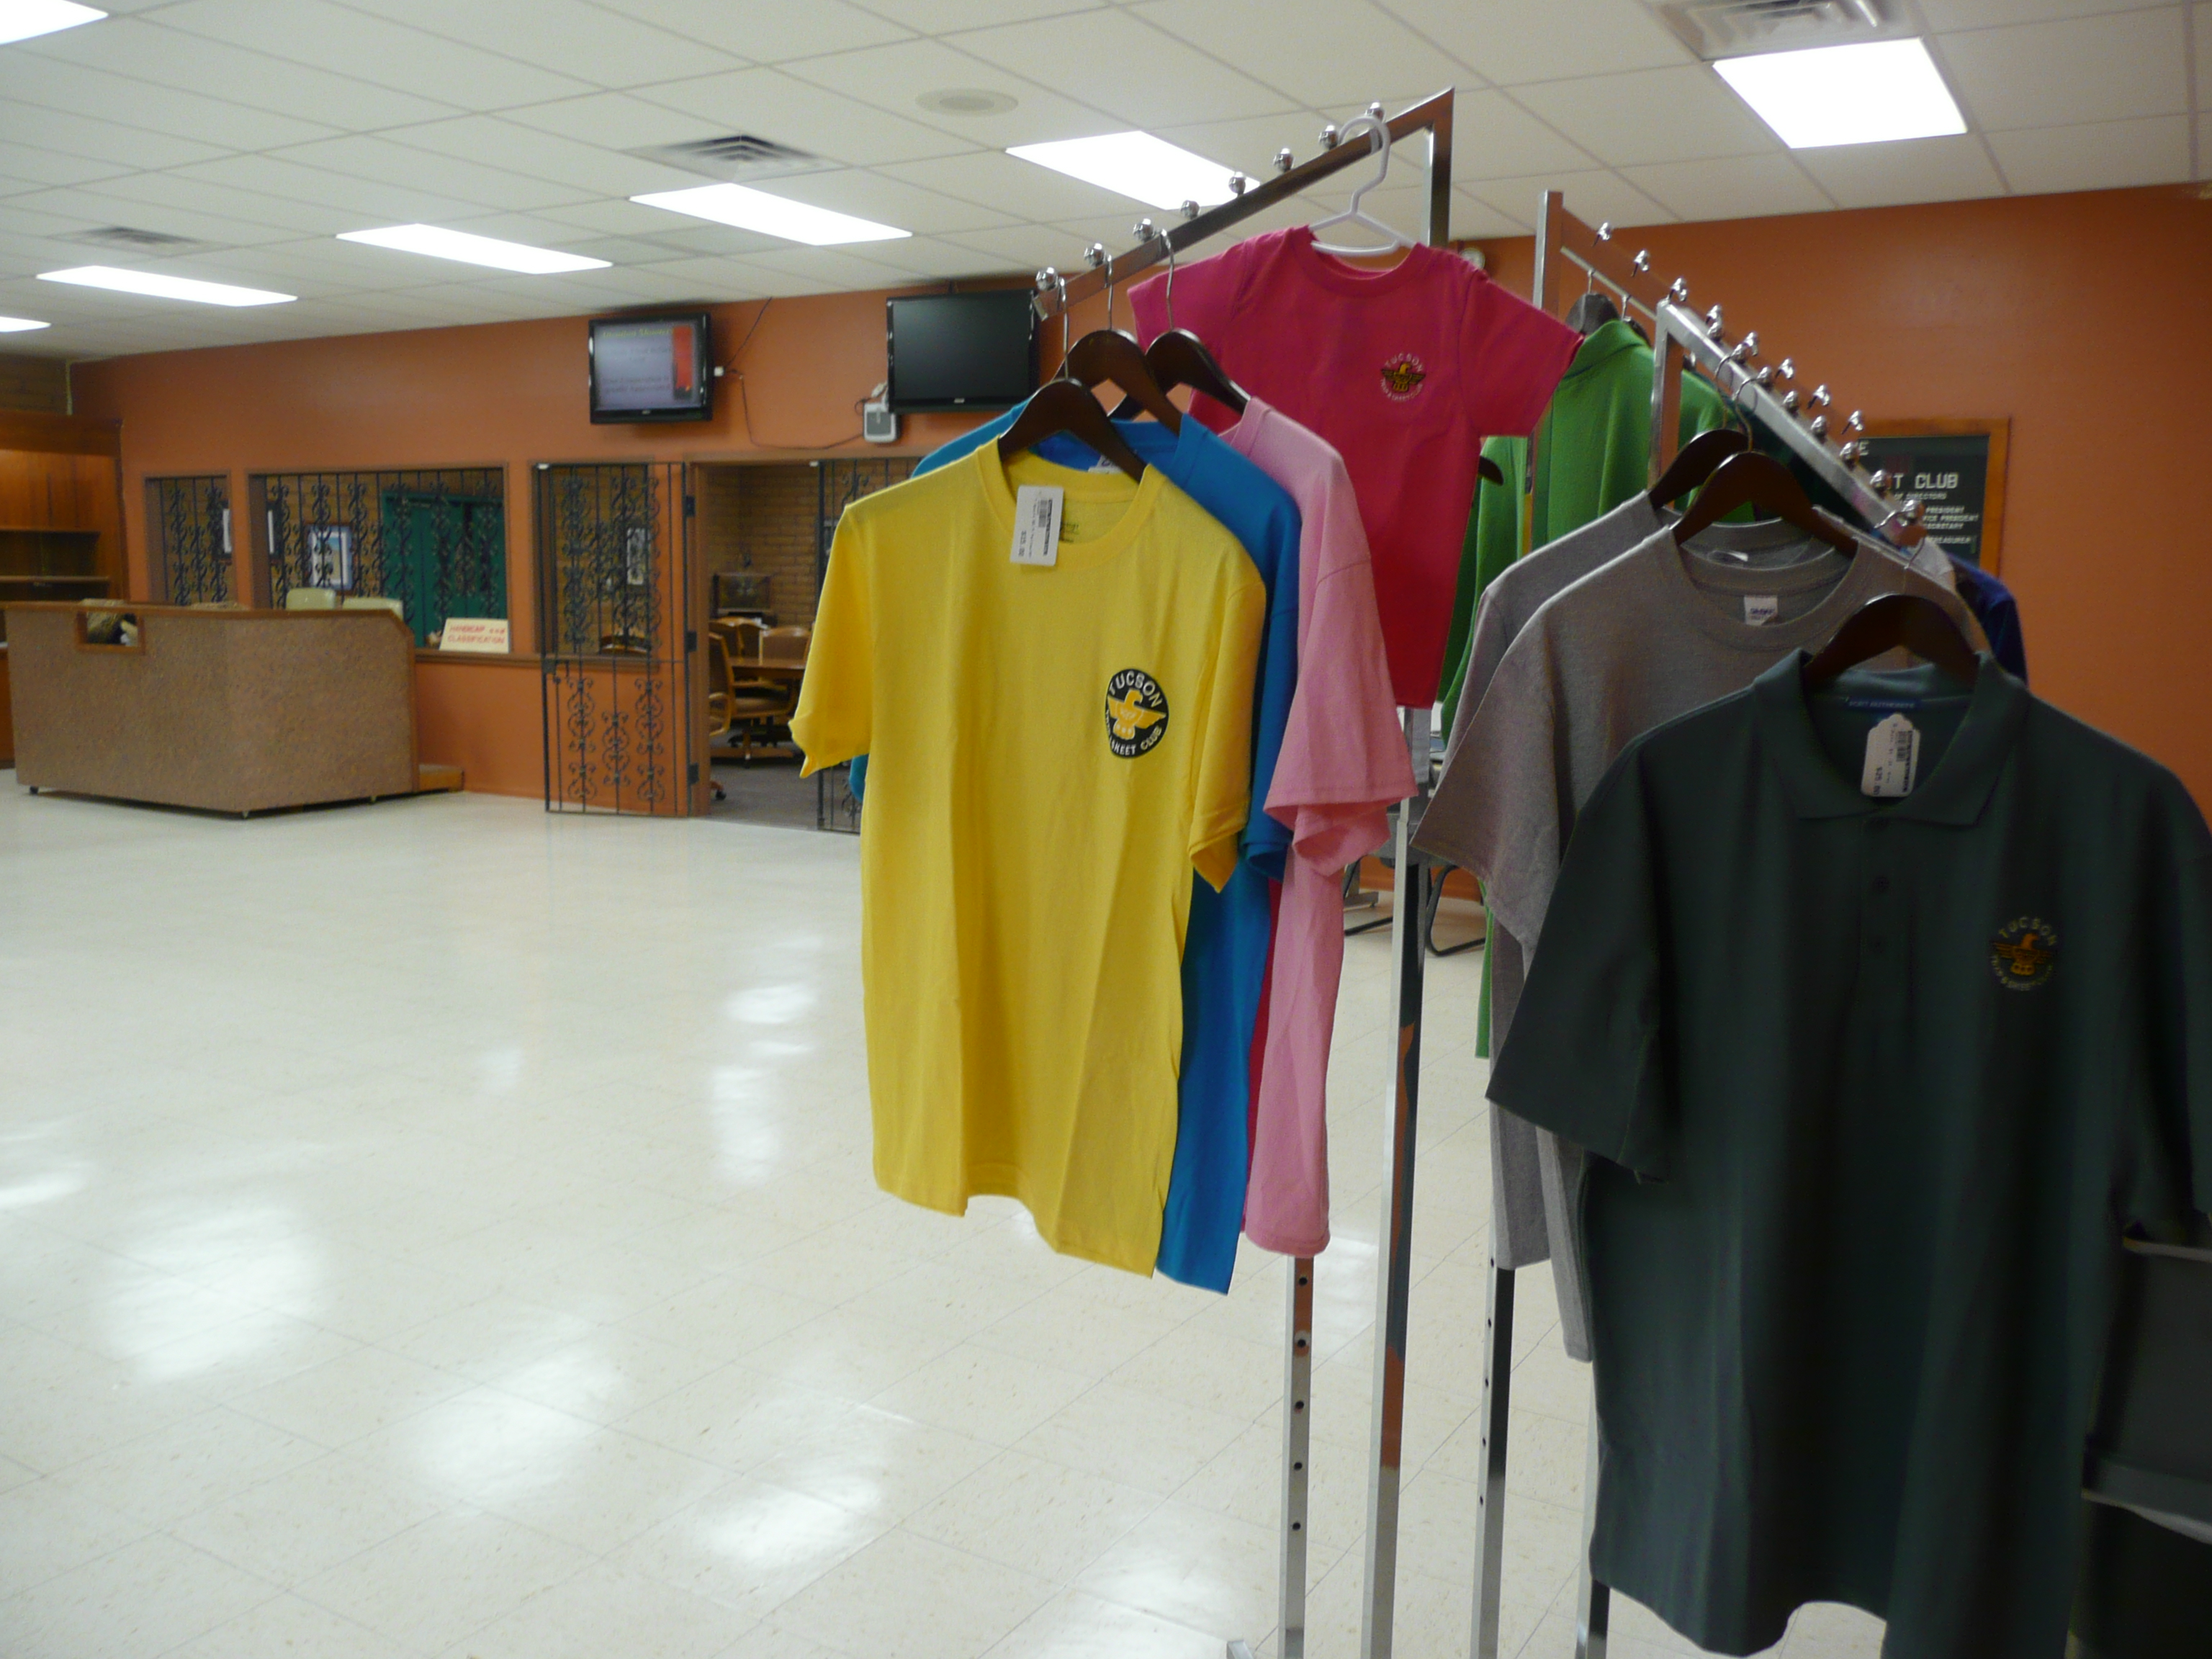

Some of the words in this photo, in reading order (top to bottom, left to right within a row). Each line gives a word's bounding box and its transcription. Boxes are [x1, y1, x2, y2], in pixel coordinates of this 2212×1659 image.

[1385, 353, 1424, 372] TUCSON
[1914, 472, 1959, 489] CLUB
[1925, 505, 1965, 514] PRESIDENT
[1940, 513, 1979, 522] PRESIDENT
[1109, 670, 1163, 708] TUCSON
[1140, 725, 1163, 750] CLUB
[1998, 917, 2058, 946] TUCSON
